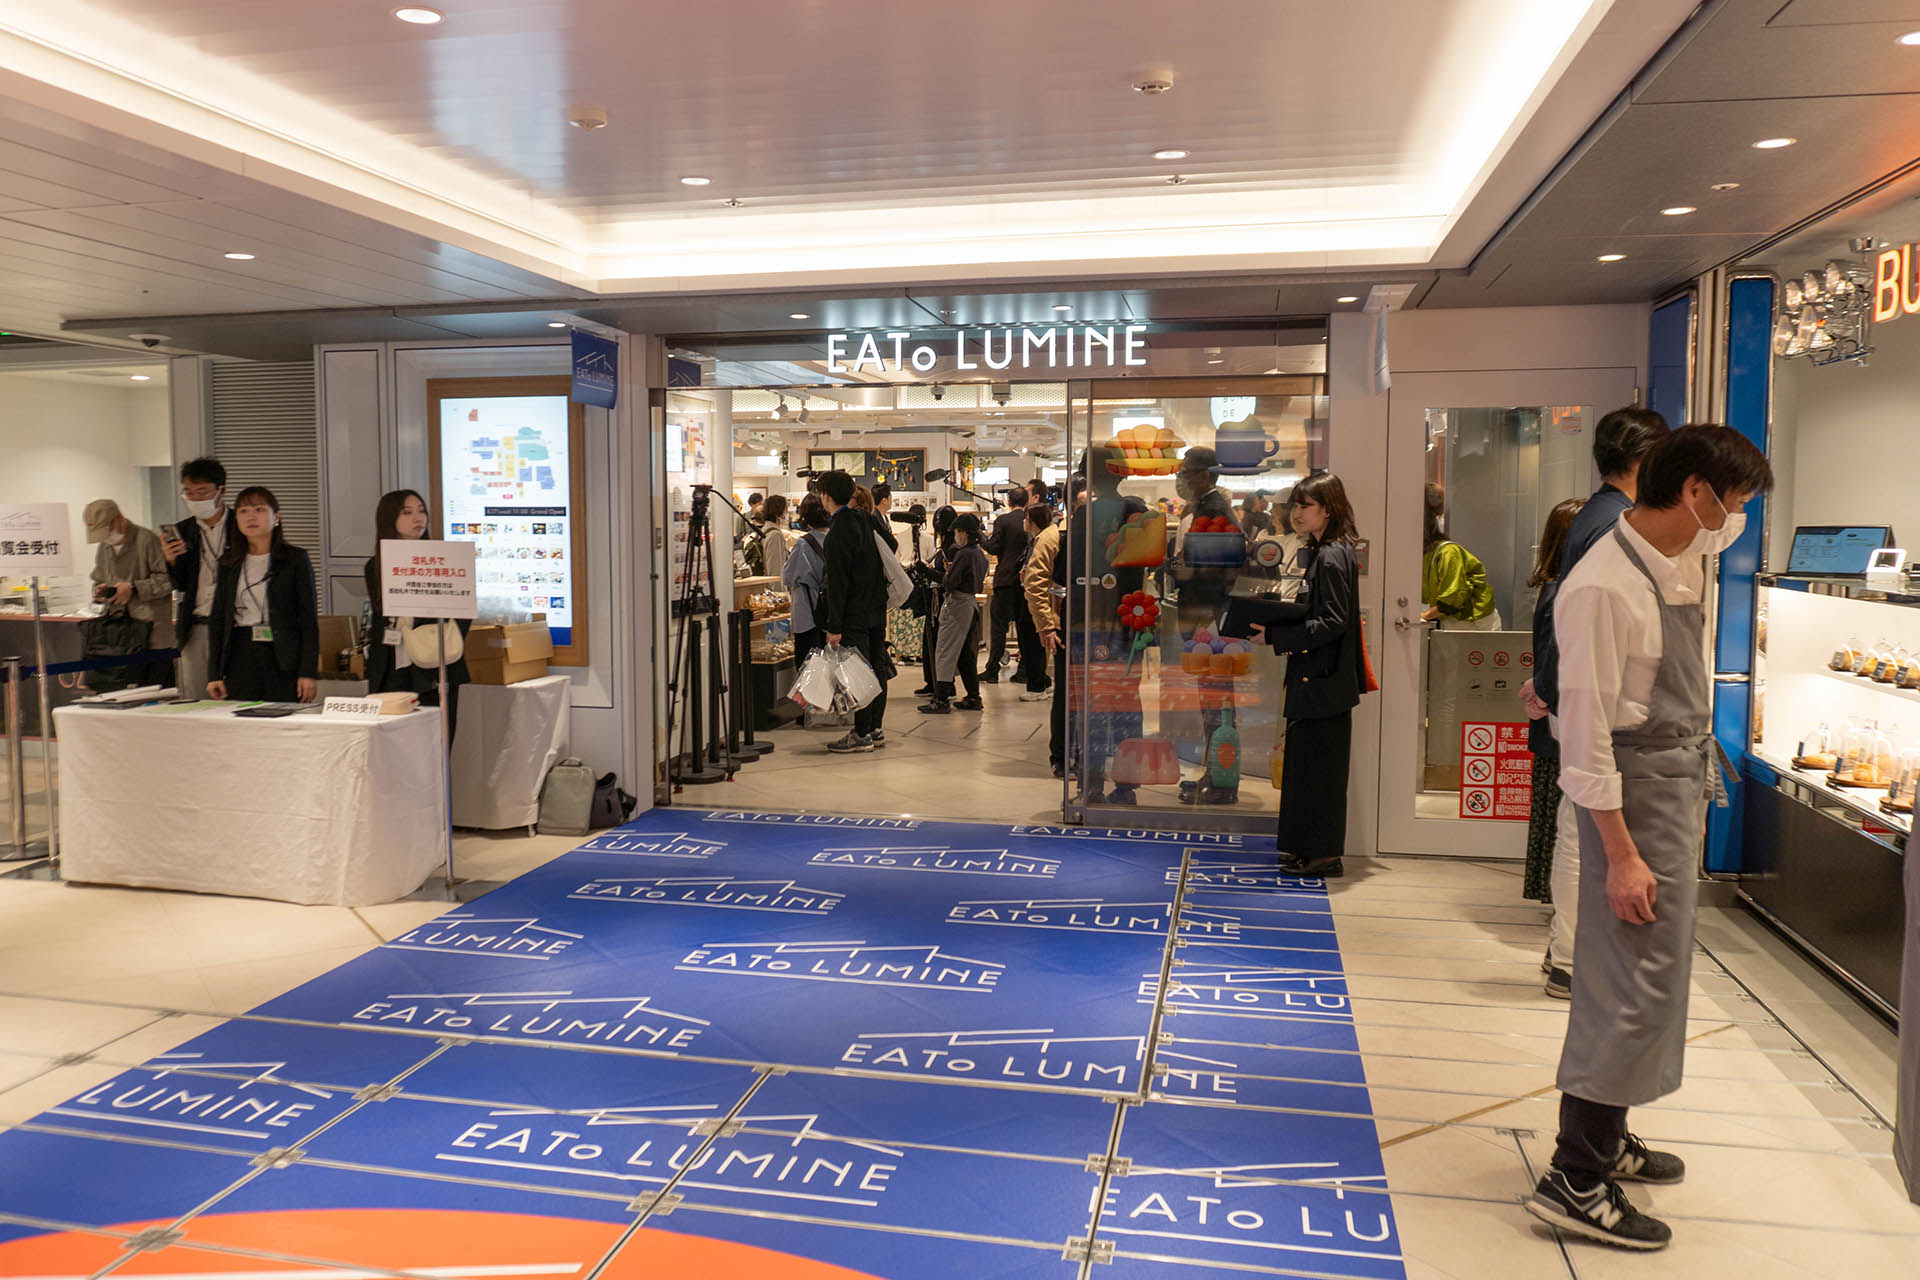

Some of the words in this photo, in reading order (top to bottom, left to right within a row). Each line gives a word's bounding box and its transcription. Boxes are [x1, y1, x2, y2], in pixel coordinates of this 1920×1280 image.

[827, 332, 937, 373] EATo
[957, 325, 1148, 370] LUMINE
[0, 541, 59, 555] 覧会受付
[794, 815, 923, 828] LUMINE
[584, 839, 723, 855] LUMINE
[1106, 829, 1243, 844] LUMINE
[811, 852, 897, 865] EATo
[912, 857, 1060, 874] LUMINE
[575, 883, 666, 898] EATo
[681, 889, 841, 910] LUMINE
[949, 906, 1049, 923] EATo
[1068, 913, 1240, 934] LUMNE
[399, 930, 574, 954] LUMINE
[682, 950, 791, 970] EATo
[810, 959, 1002, 985] LUMINE
[353, 1002, 473, 1027] EATo
[489, 1014, 702, 1047] LUMINE
[841, 1043, 975, 1072] EATo
[1002, 1055, 1237, 1093] LUMNE
[76, 1081, 316, 1128] LUMINE
[451, 1122, 602, 1160] EATo
[626, 1140, 898, 1192] LUMINE
